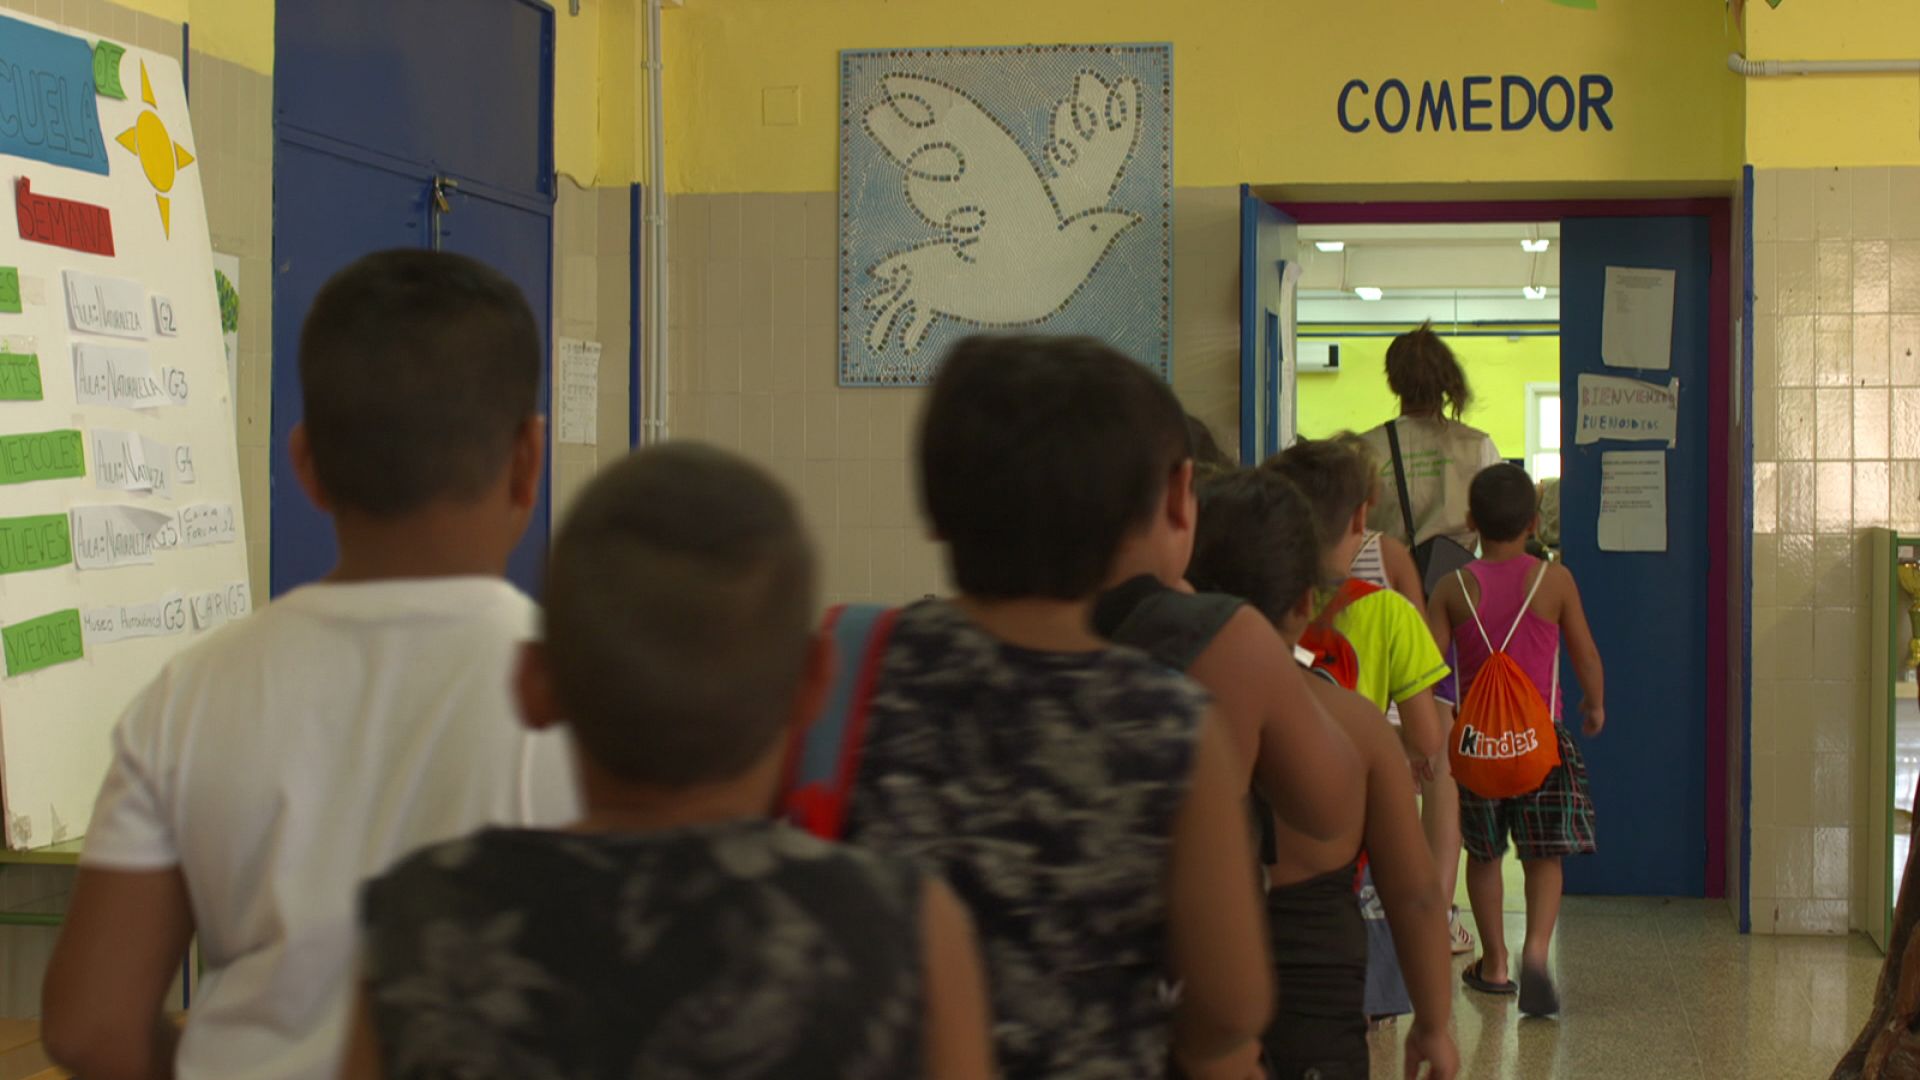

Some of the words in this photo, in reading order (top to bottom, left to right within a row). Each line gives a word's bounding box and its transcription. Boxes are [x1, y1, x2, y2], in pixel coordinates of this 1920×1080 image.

[1337, 74, 1613, 133] COMEDOR
[18, 184, 111, 251] SEMANA
[159, 302, 176, 332] G2
[168, 369, 188, 399] G3
[164, 598, 186, 631] G3
[6, 618, 81, 667] VIERNES
[1459, 724, 1538, 758] kinder
